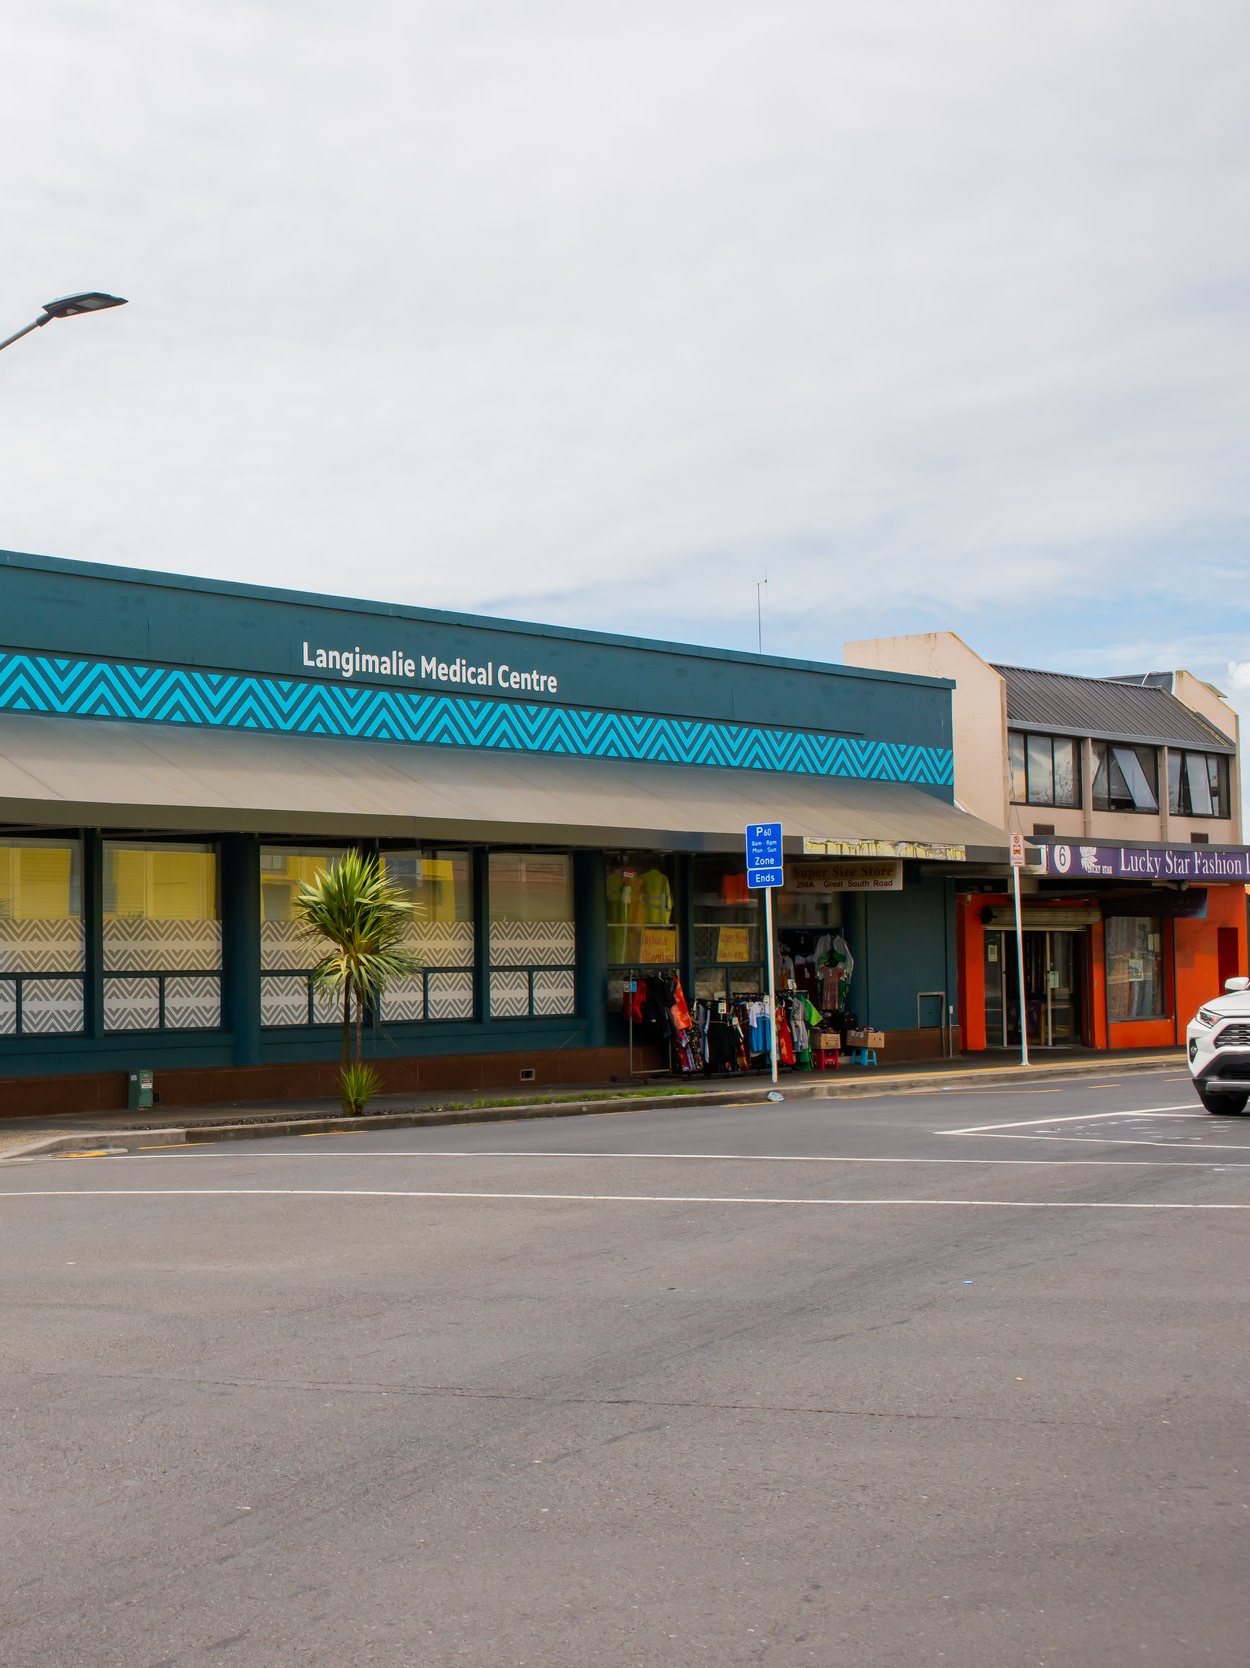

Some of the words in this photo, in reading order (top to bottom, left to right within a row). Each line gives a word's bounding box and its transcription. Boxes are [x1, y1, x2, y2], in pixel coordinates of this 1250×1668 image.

[302, 642, 416, 677] Langimalie
[421, 655, 493, 686] Medical
[497, 665, 558, 693] Centre
[755, 857, 775, 866] Zone
[1059, 846, 1066, 866] 6
[1120, 848, 1161, 878] Lucky
[1165, 851, 1190, 874] Star
[1194, 852, 1242, 875] Fashion
[755, 874, 775, 883] Ends
[793, 867, 827, 879] Super
[832, 866, 856, 877] Size
[861, 865, 895, 877] Store
[823, 880, 844, 888] Great
[873, 879, 893, 887] Road
